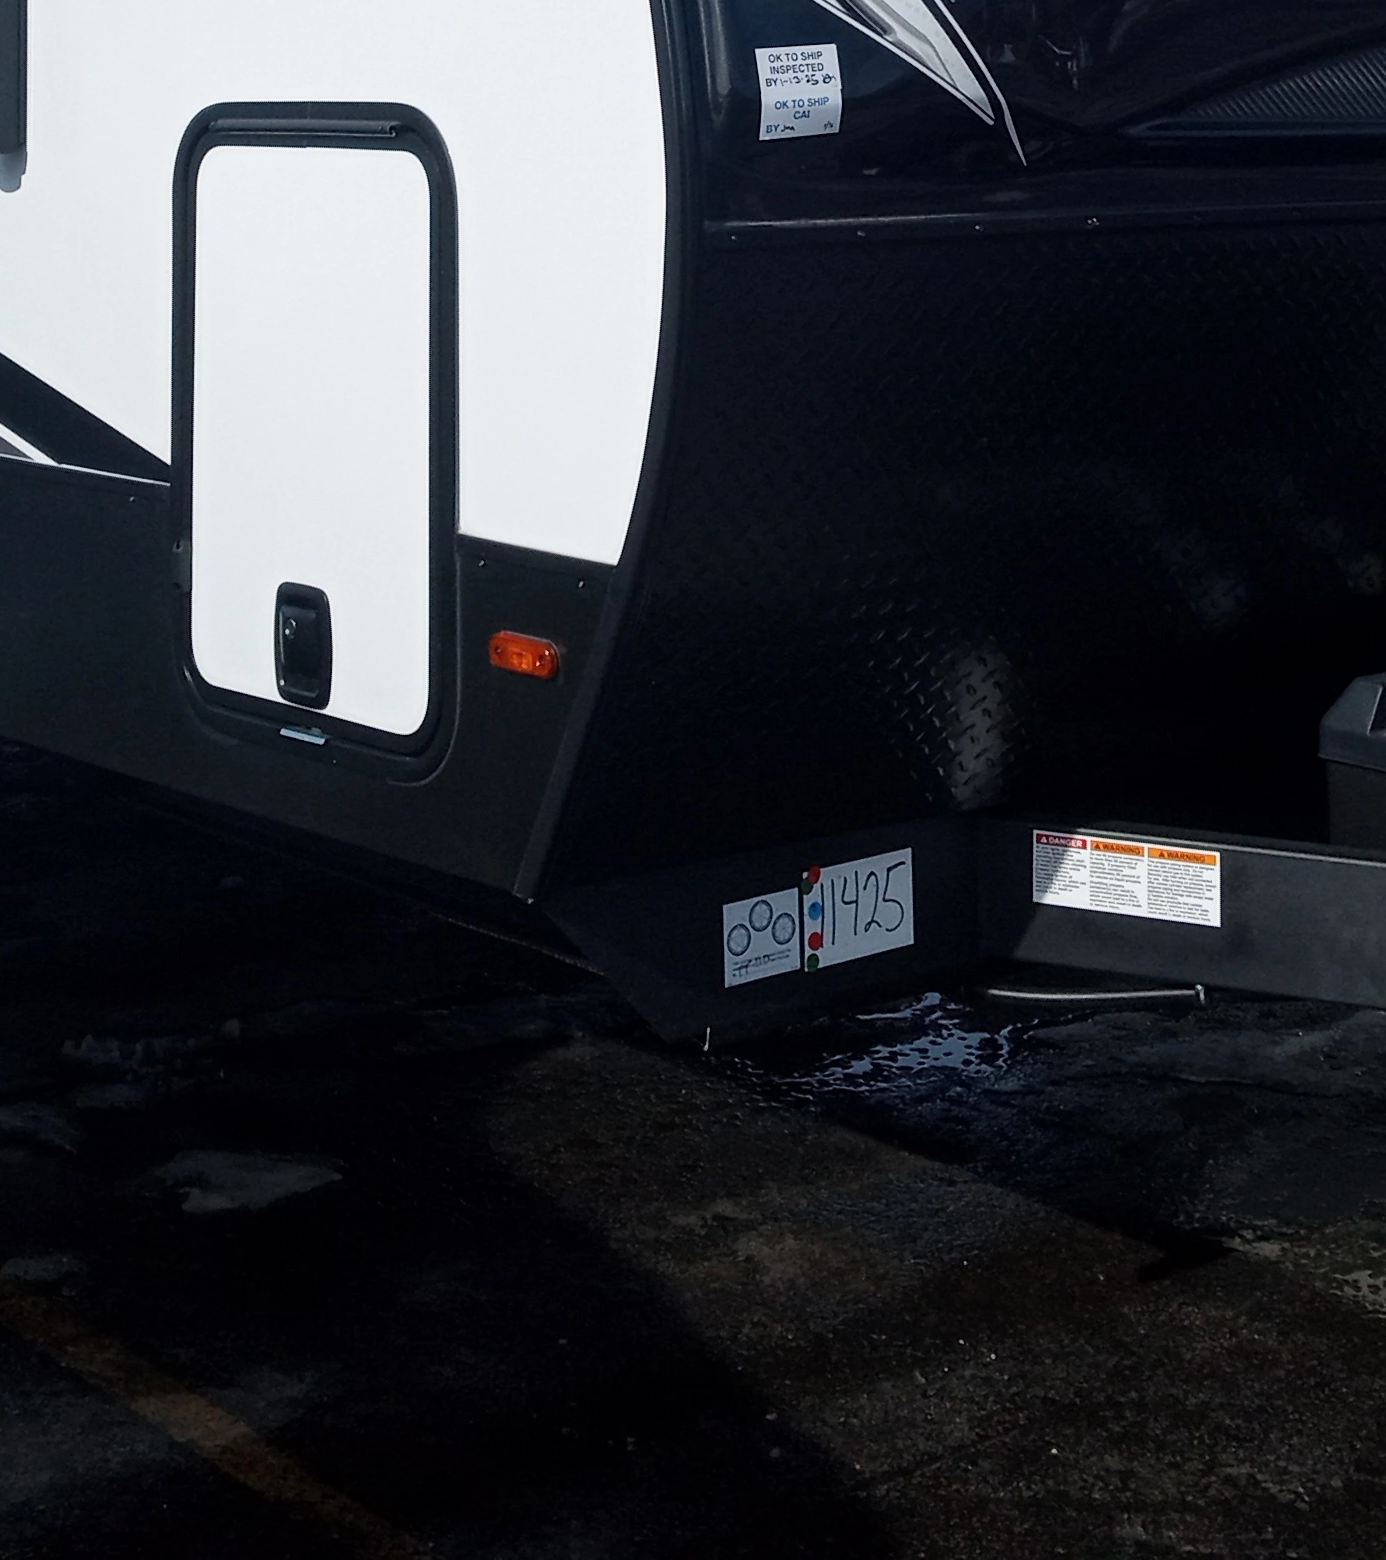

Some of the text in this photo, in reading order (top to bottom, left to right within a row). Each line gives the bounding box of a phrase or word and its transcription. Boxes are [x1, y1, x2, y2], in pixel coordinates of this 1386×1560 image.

[768, 50, 823, 63] OK TO SHIP
[769, 62, 824, 75] INSPECTED
[765, 78, 778, 87] BY
[774, 96, 830, 110] OK TO SHIP
[766, 124, 780, 134] BY
[1048, 836, 1083, 848] DANGER
[1102, 843, 1141, 855] WARNING
[1166, 850, 1206, 863] WARNING
[820, 860, 907, 949] 11425
